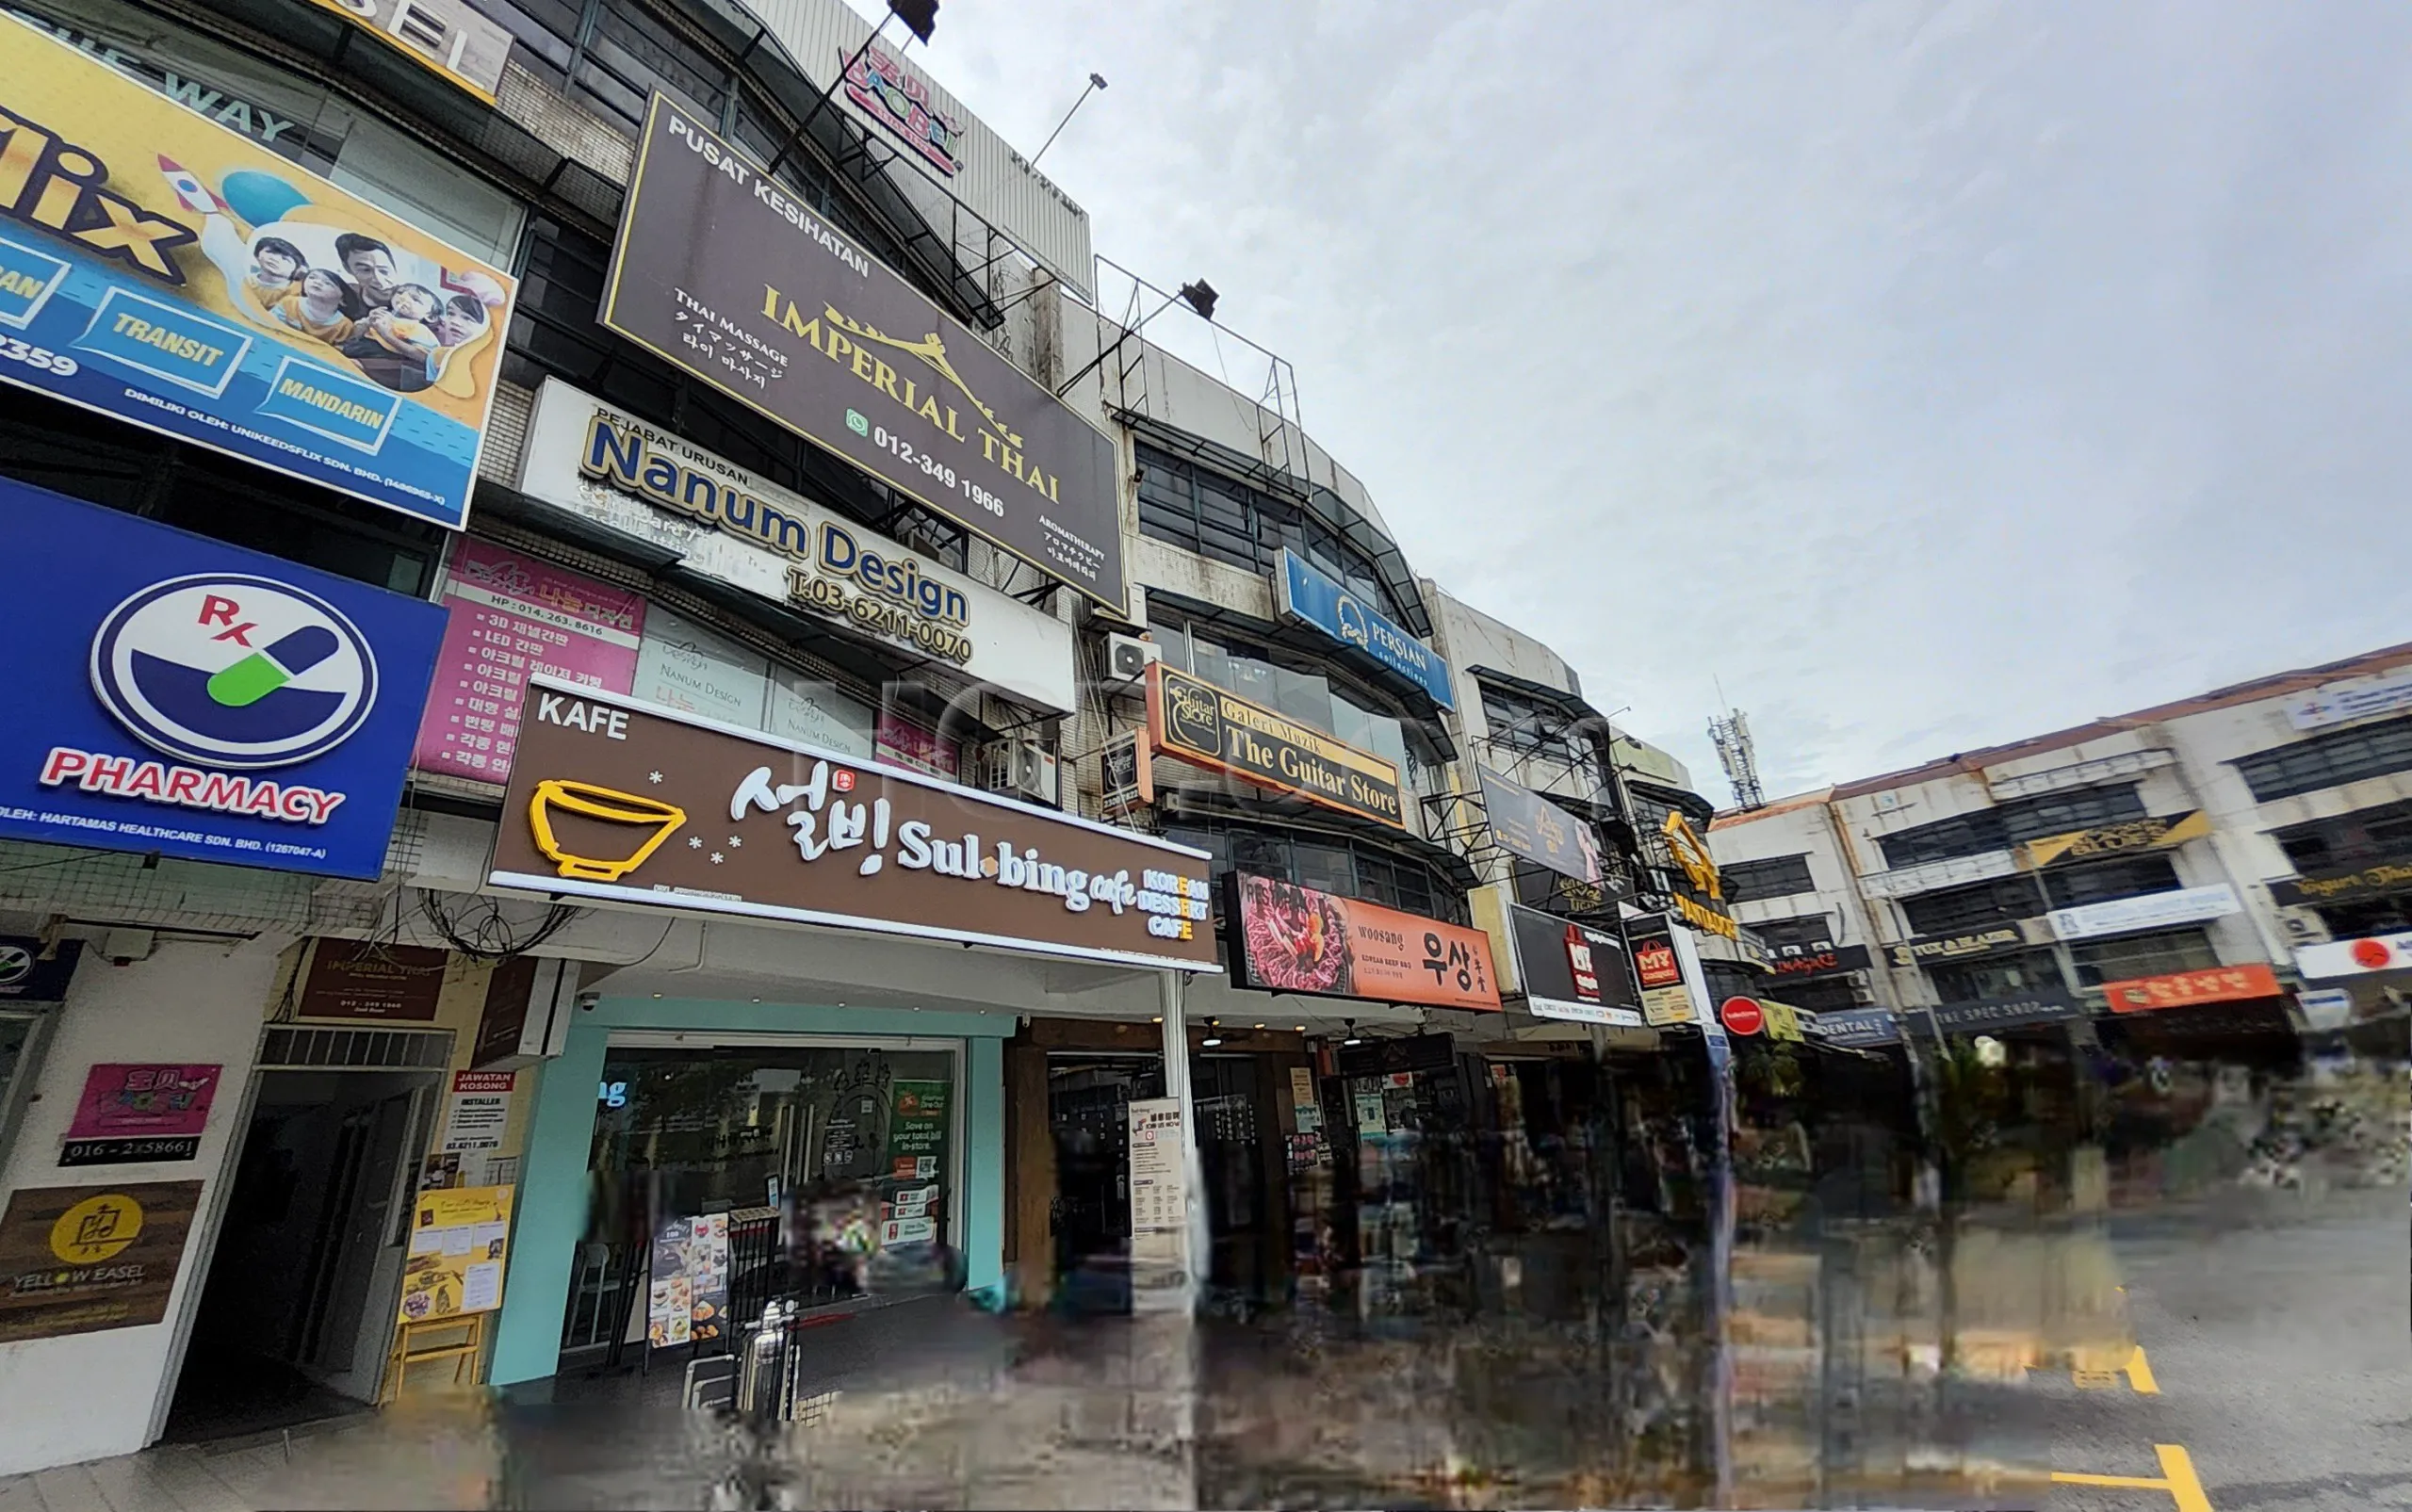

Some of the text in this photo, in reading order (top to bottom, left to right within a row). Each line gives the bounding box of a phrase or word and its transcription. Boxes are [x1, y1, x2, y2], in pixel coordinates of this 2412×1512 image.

[164, 71, 294, 142] WAY
[669, 115, 870, 278] PUSAT KESIHATAN
[112, 311, 224, 367] TRANSIT
[675, 287, 790, 367] THAI MASSAGE
[721, 355, 766, 389] 마사지
[759, 284, 1061, 505] IMPERIAL THAI
[279, 378, 384, 430] MANDARIN
[124, 388, 186, 415] DIMILIKI
[231, 425, 323, 463] UNIKEEDSFLIX
[323, 457, 352, 473] SDN.
[353, 467, 383, 482] BHD.
[596, 407, 749, 486] PEJABAT URUSAN
[873, 426, 1005, 518] 012-349 1966
[585, 417, 809, 558] Nanum
[820, 522, 970, 626] Design
[488, 614, 509, 629] 3D
[491, 594, 510, 607] HP
[575, 620, 603, 636] 8616
[786, 565, 973, 663] T.03-6211-0070
[484, 630, 511, 647] LED
[1371, 621, 1426, 672] PERSIAN
[537, 692, 630, 740] KAFE
[1223, 700, 1274, 735] Galeri
[1279, 723, 1322, 755] Muzik
[42, 749, 343, 823] PHARMACY
[1224, 723, 1275, 769] The
[1279, 745, 1346, 798] Guitar
[1348, 774, 1397, 816] Store
[39, 811, 118, 832] HARTAMAS
[118, 822, 204, 844] HEALTHCARE
[204, 834, 233, 848] SDN.
[234, 837, 263, 852] BHD.
[1088, 869, 1137, 916] cafe
[1136, 890, 1209, 922] DESSERT
[1142, 868, 1210, 902] KOREAN
[1147, 915, 1195, 941] CAFE
[1422, 932, 1473, 992] 우상
[1639, 950, 1670, 971] MY
[124, 1069, 181, 1092] 宝贝
[458, 1073, 512, 1081] JAWATAN
[459, 1081, 508, 1090] KOSONG
[892, 1133, 911, 1144] your
[904, 1121, 923, 1130] Save
[71, 1144, 106, 1158] 016
[93, 1264, 147, 1281] EASEL
